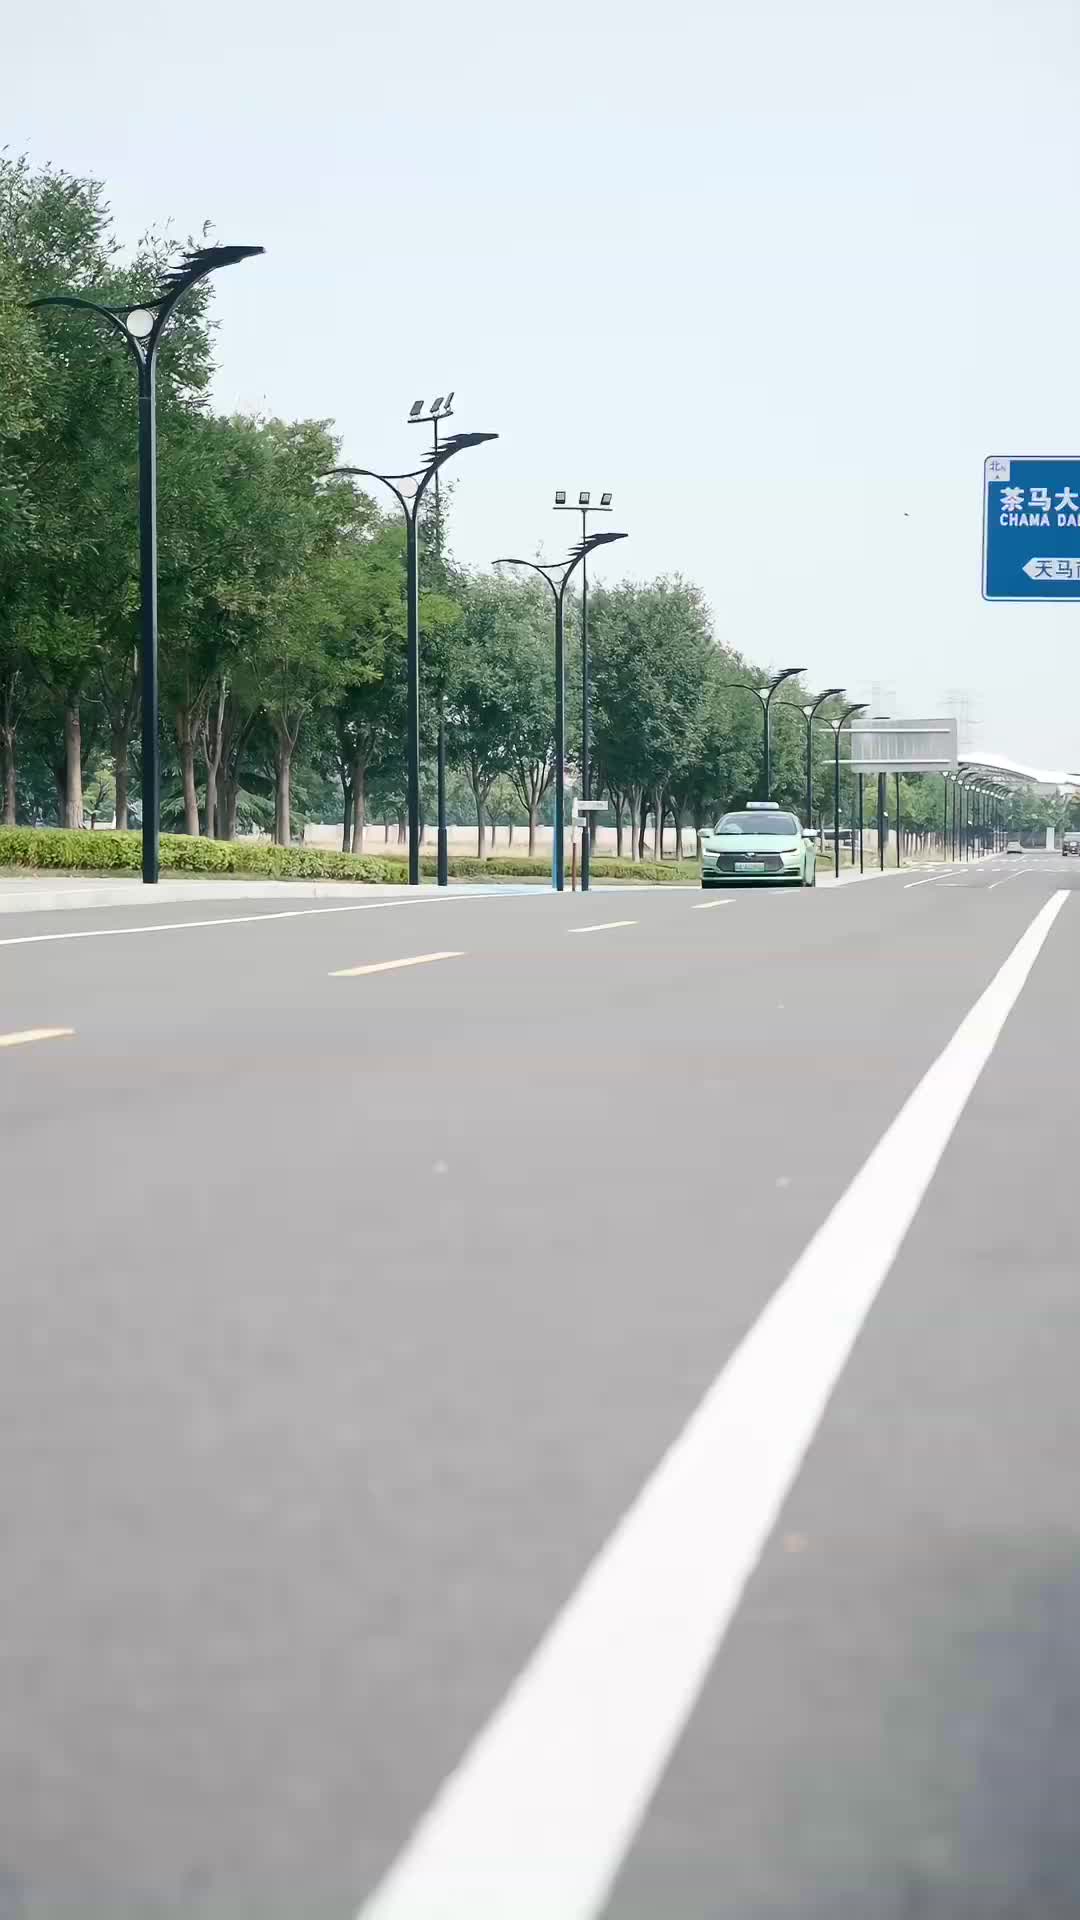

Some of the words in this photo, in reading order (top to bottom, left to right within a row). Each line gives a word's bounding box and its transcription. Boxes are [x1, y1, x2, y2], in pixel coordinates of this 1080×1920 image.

[999, 486, 1080, 512] 茶马大
[999, 513, 1051, 527] CHAMA
[1057, 513, 1080, 527] DA
